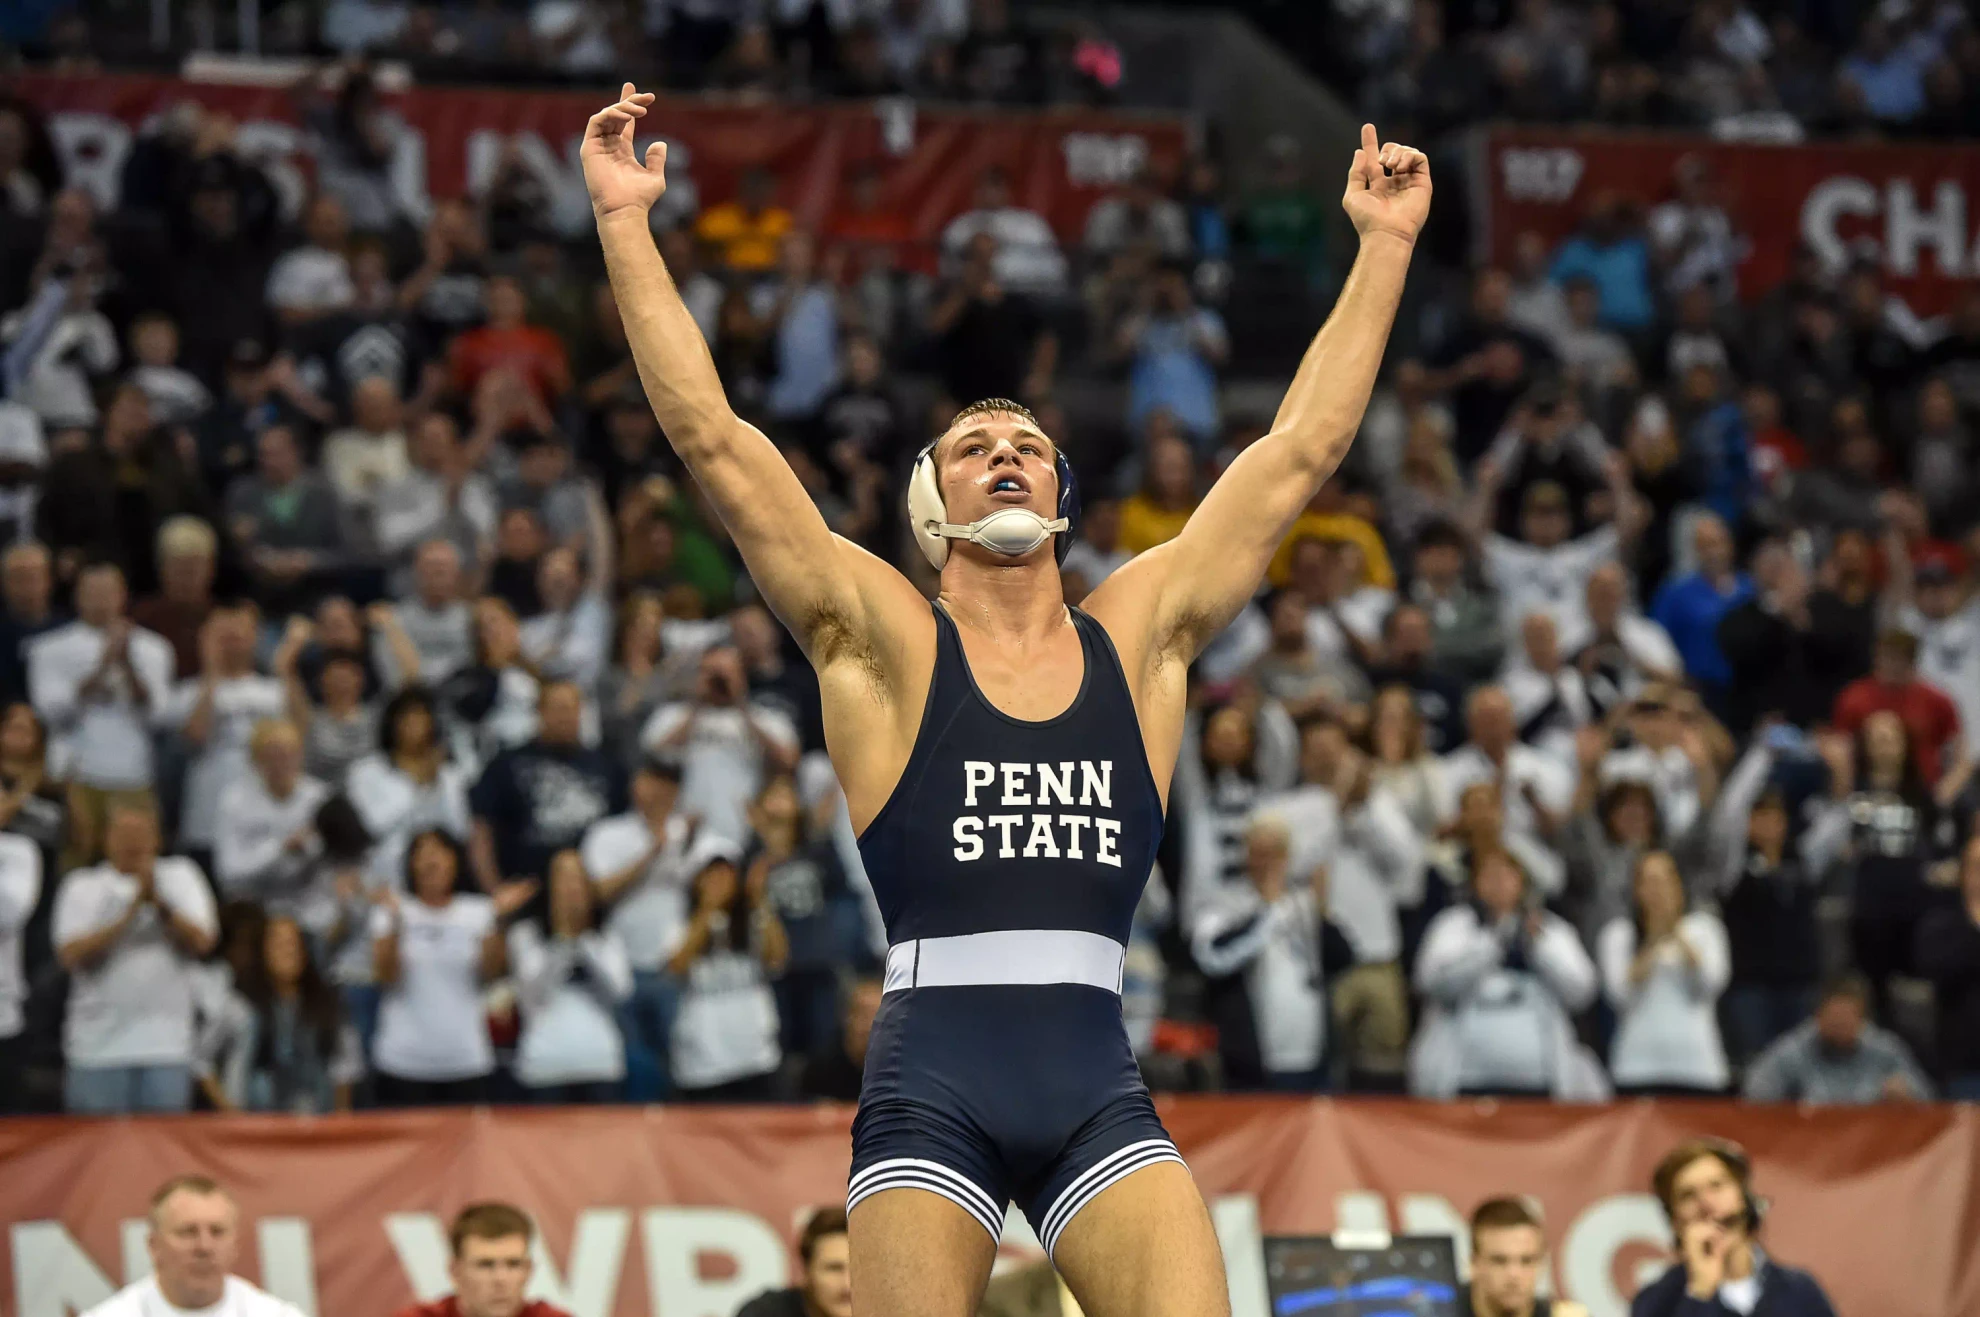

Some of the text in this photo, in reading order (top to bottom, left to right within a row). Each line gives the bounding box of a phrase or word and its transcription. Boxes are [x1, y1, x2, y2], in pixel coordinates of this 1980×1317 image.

[1803, 176, 1980, 277] CH
[964, 760, 1113, 808] PENN
[952, 814, 1122, 868] STATE
